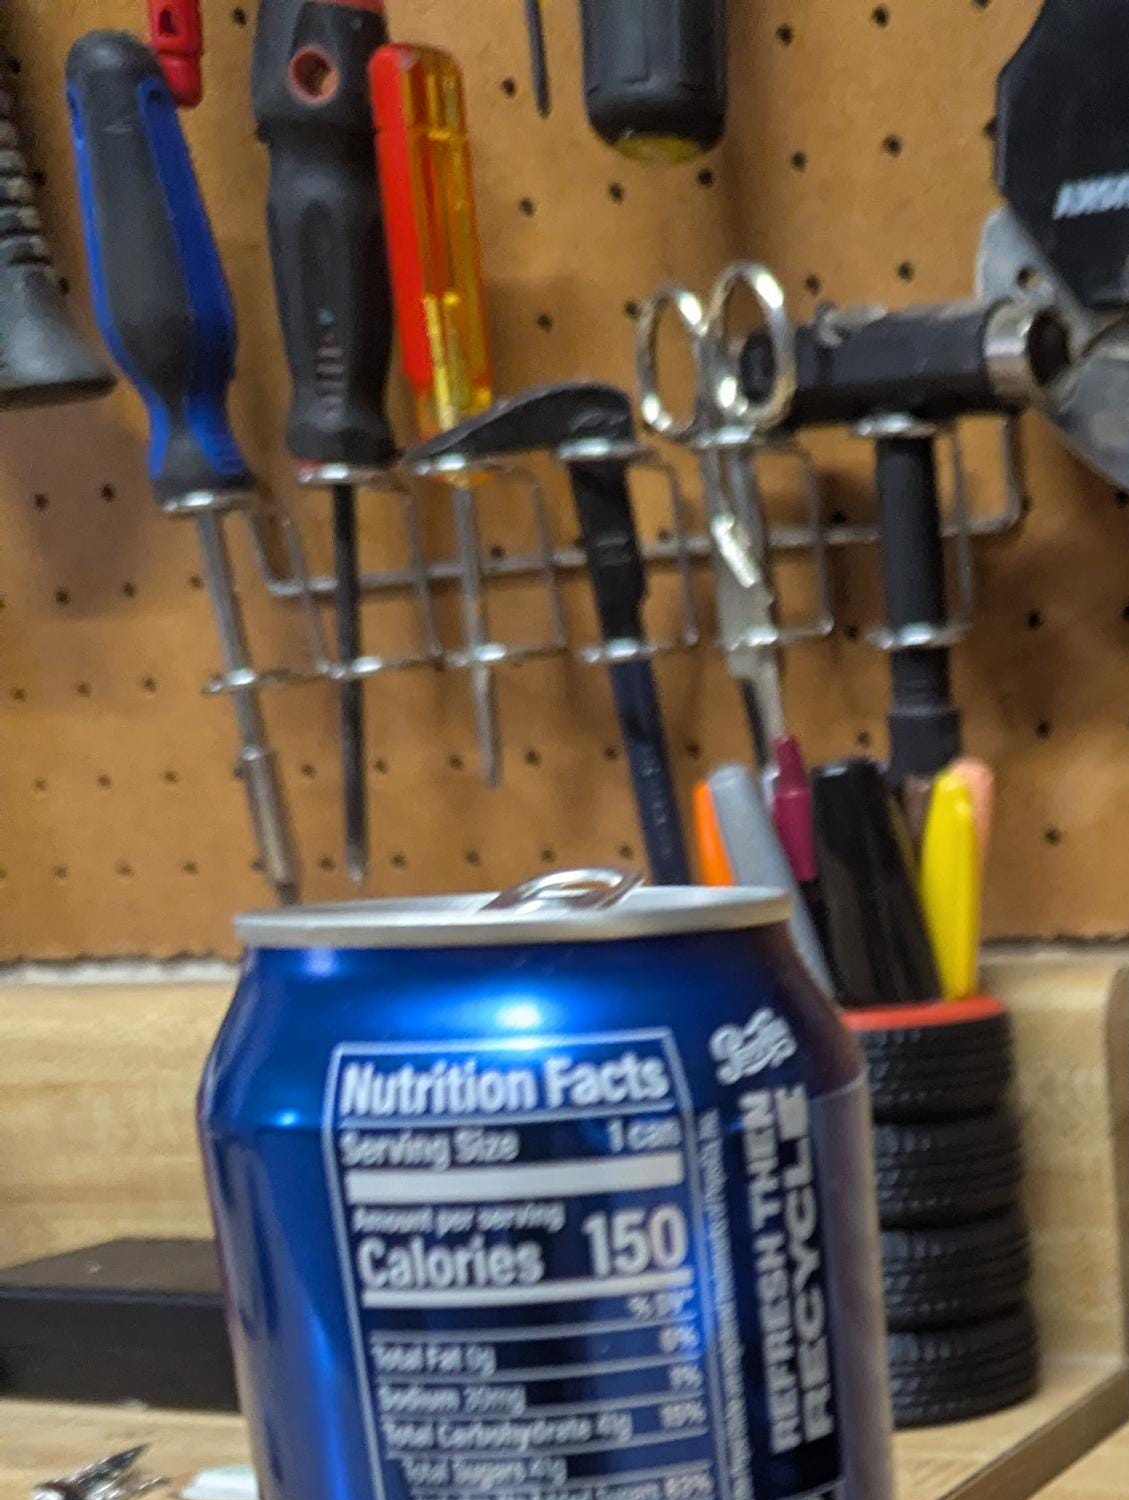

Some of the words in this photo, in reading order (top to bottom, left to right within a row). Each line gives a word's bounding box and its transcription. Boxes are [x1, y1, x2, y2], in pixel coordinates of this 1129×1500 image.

[342, 1058, 537, 1116] Nutrition
[546, 1051, 672, 1105] Facts
[340, 1129, 449, 1171] Serving
[456, 1125, 520, 1164] Size
[607, 1120, 624, 1151] 1
[627, 1117, 681, 1148] can
[743, 1090, 781, 1229] THEN
[357, 1233, 545, 1289] Calories
[583, 1206, 687, 1276] 150
[436, 1208, 473, 1238] per
[477, 1201, 565, 1233] serving
[777, 1084, 833, 1439] RECYCLE
[754, 1231, 798, 1452] REFRESH
